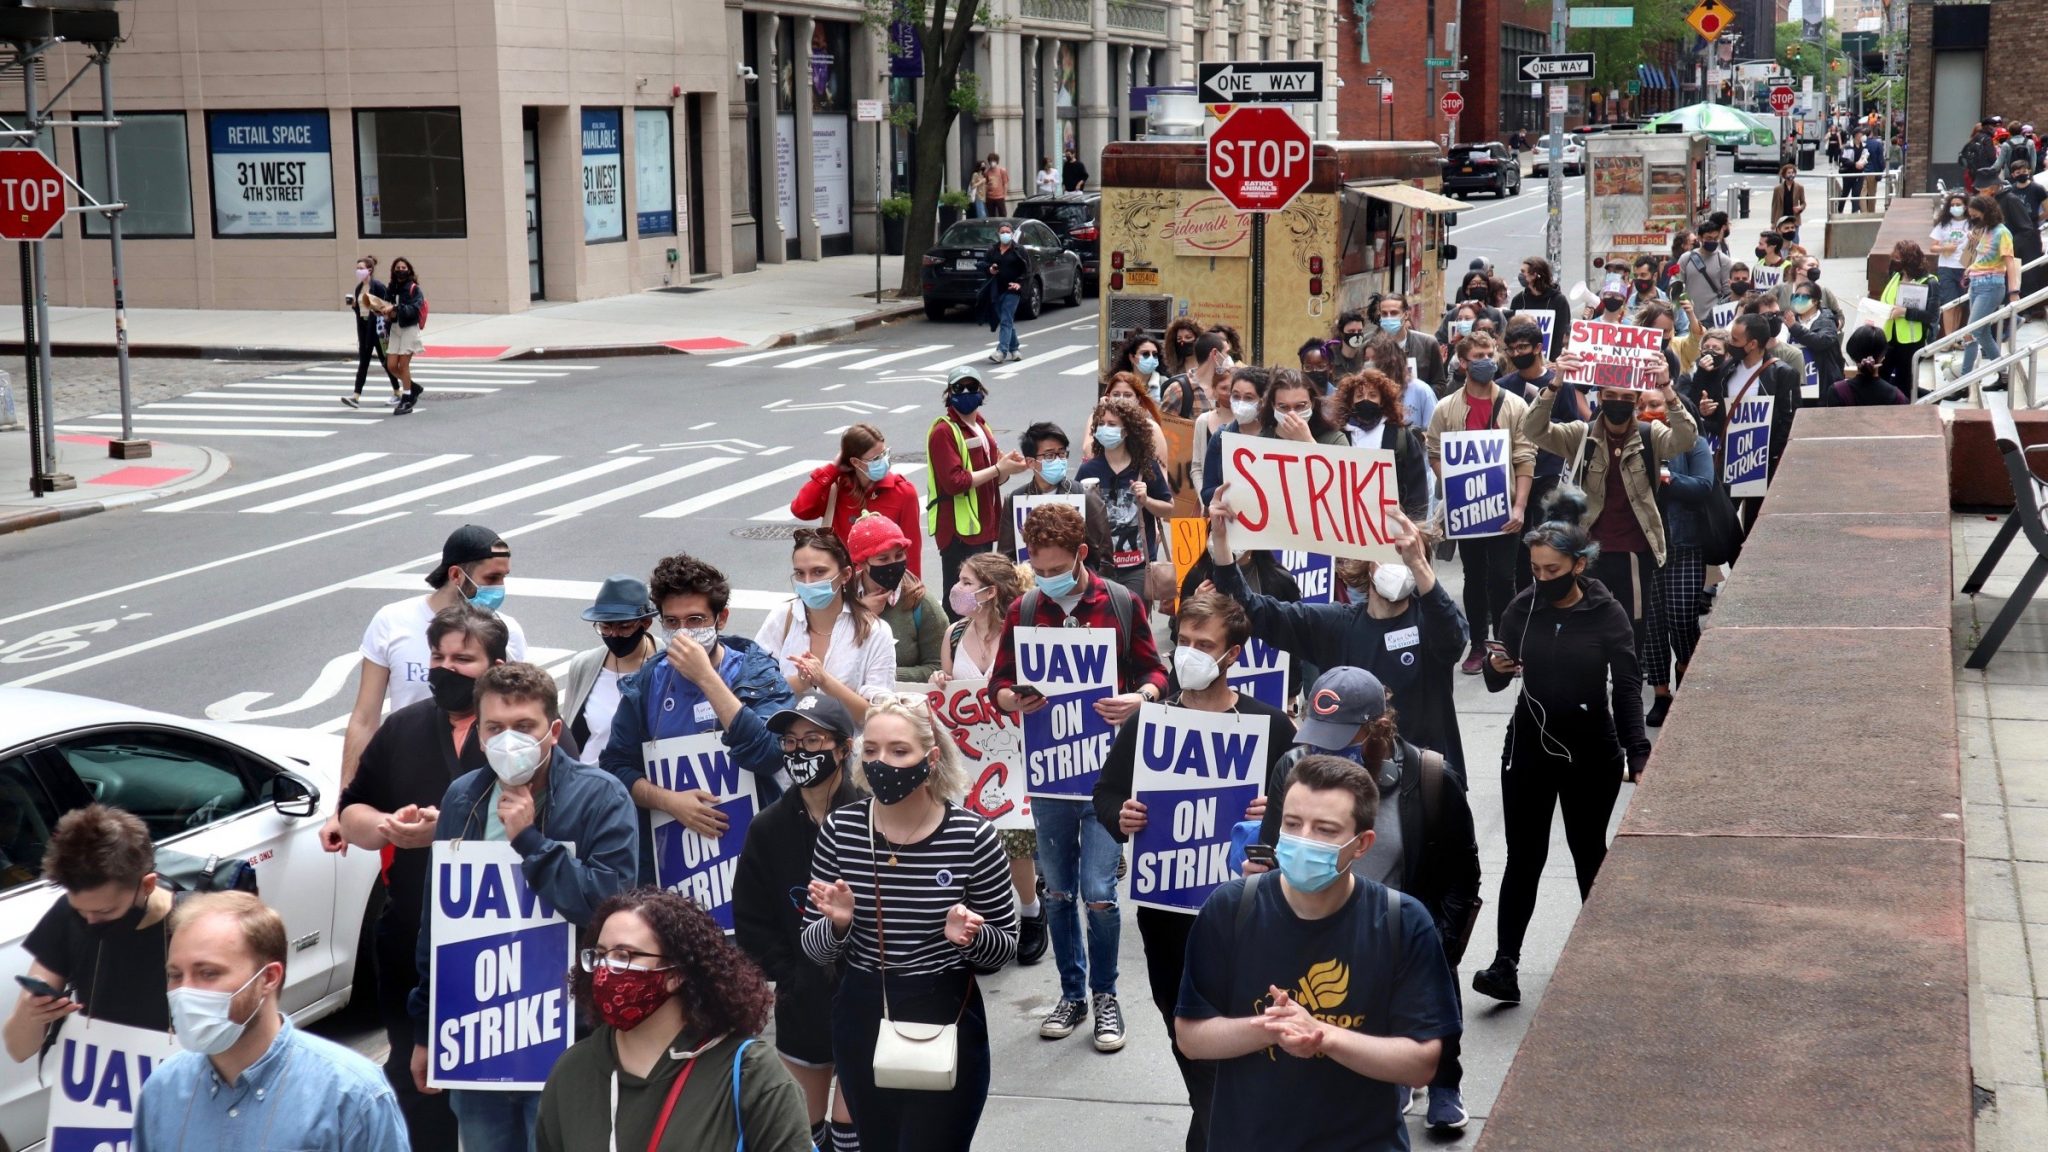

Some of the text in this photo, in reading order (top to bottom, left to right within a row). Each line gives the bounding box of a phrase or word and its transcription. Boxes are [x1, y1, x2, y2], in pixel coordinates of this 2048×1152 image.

[1532, 62, 1584, 73] ONE WAY
[1218, 74, 1307, 91] ONE WAY
[1442, 99, 1462, 109] STOP
[1771, 94, 1794, 104] STOP
[228, 125, 312, 145] RETAIL SPACE
[582, 129, 616, 149] AVAILABLE
[1214, 139, 1306, 178] STOP
[237, 161, 307, 186] 31 WEST
[583, 164, 617, 191] 31 WEST
[0, 178, 60, 212] TOP
[242, 186, 305, 202] 4TH STREET
[586, 190, 616, 206] 4TH STREET
[1160, 214, 1228, 239] Sidewalk
[1615, 236, 1665, 245] Halal Food
[1755, 268, 1780, 286] UAW
[1715, 308, 1736, 328] UA
[1571, 321, 1662, 351] STRIKE
[1612, 347, 1640, 357] NYU
[1731, 401, 1770, 424] UAW
[1444, 439, 1504, 466] UAW
[1737, 430, 1753, 455] ON
[1726, 445, 1767, 484] STRIKE
[1233, 447, 1398, 546] STRIKE
[1464, 473, 1487, 501] ON
[1450, 492, 1506, 532] STRIKE
[1113, 552, 1140, 563] Sanders
[1281, 550, 1308, 571] ON
[404, 661, 429, 682] Fa
[1020, 643, 1108, 684] UAW
[1051, 699, 1083, 741] ON
[1029, 732, 1110, 786] STRIKE
[1143, 722, 1259, 781] UAW
[1173, 797, 1217, 843] ON
[247, 848, 274, 866] SE ONLY
[682, 826, 720, 869] ON
[1136, 841, 1241, 894] STRIK
[439, 863, 556, 919] UAW
[475, 940, 521, 1002] ON
[439, 988, 561, 1071] STRIKE
